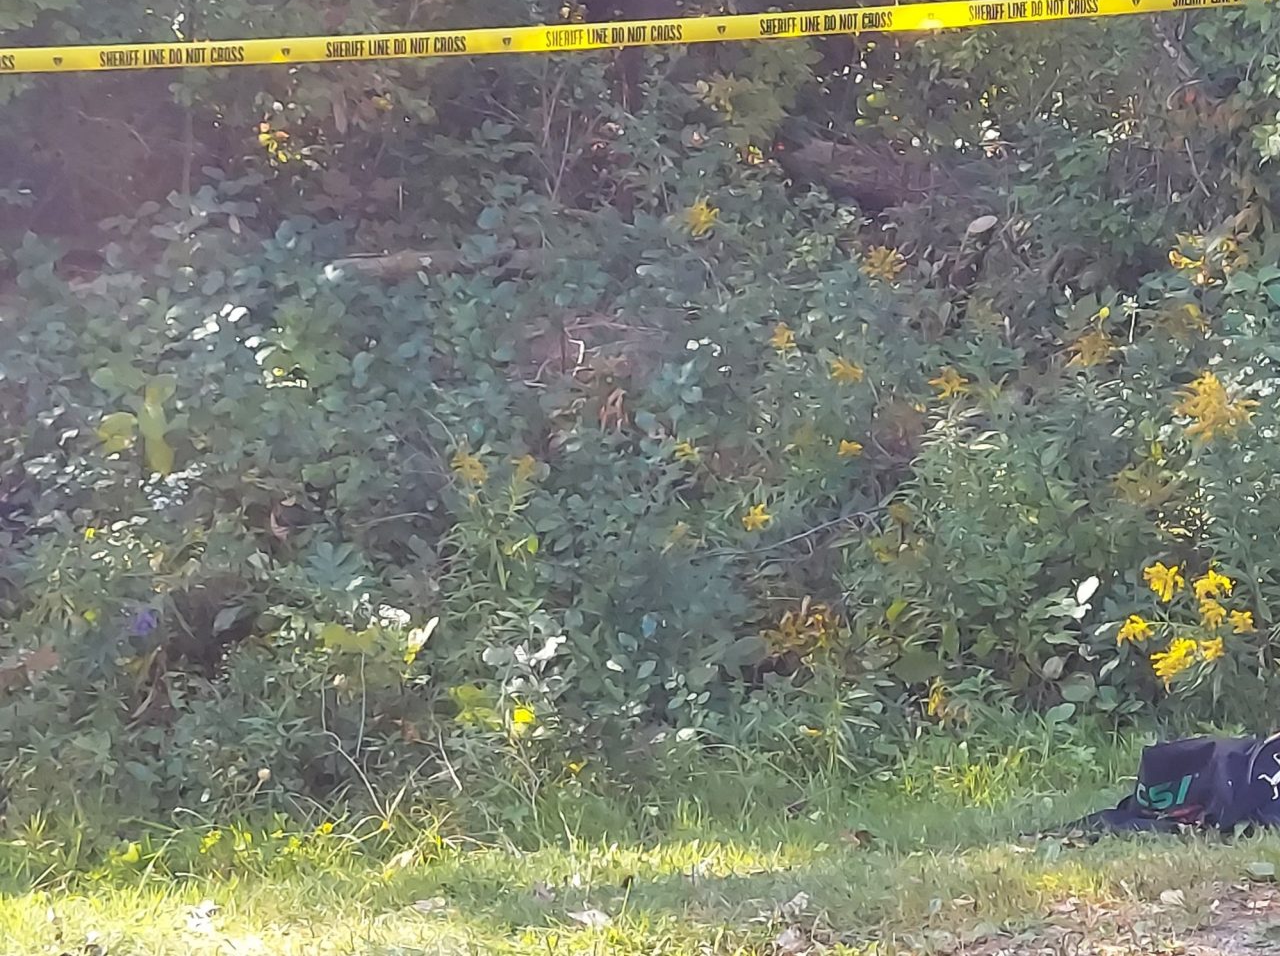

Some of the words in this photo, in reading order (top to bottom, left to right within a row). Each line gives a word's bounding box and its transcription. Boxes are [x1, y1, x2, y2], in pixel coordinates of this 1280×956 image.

[969, 3, 1005, 21] SHERIFF
[1008, 1, 1028, 19] LINE
[1031, 0, 1043, 17] DO
[1046, 0, 1064, 16] NOT
[759, 17, 797, 35] SHERIFF
[800, 15, 820, 32] LINE
[824, 14, 837, 31] DO
[839, 13, 858, 30] NOT
[862, 11, 893, 29] CROSS
[545, 29, 584, 47] SHERIFF
[587, 28, 609, 44] LINE
[612, 27, 624, 43] DO
[627, 26, 647, 42] NOT
[651, 24, 682, 41] CROSS
[100, 49, 139, 68] SHERIFF
[143, 48, 165, 65] LINE
[169, 48, 182, 65] DO
[186, 47, 206, 64] NOT
[210, 46, 244, 63] CROSS
[326, 40, 365, 58] SHERIFF
[368, 39, 391, 56] LINE
[394, 38, 407, 55] DO
[410, 37, 430, 54] NOT
[434, 36, 467, 53] CROSS
